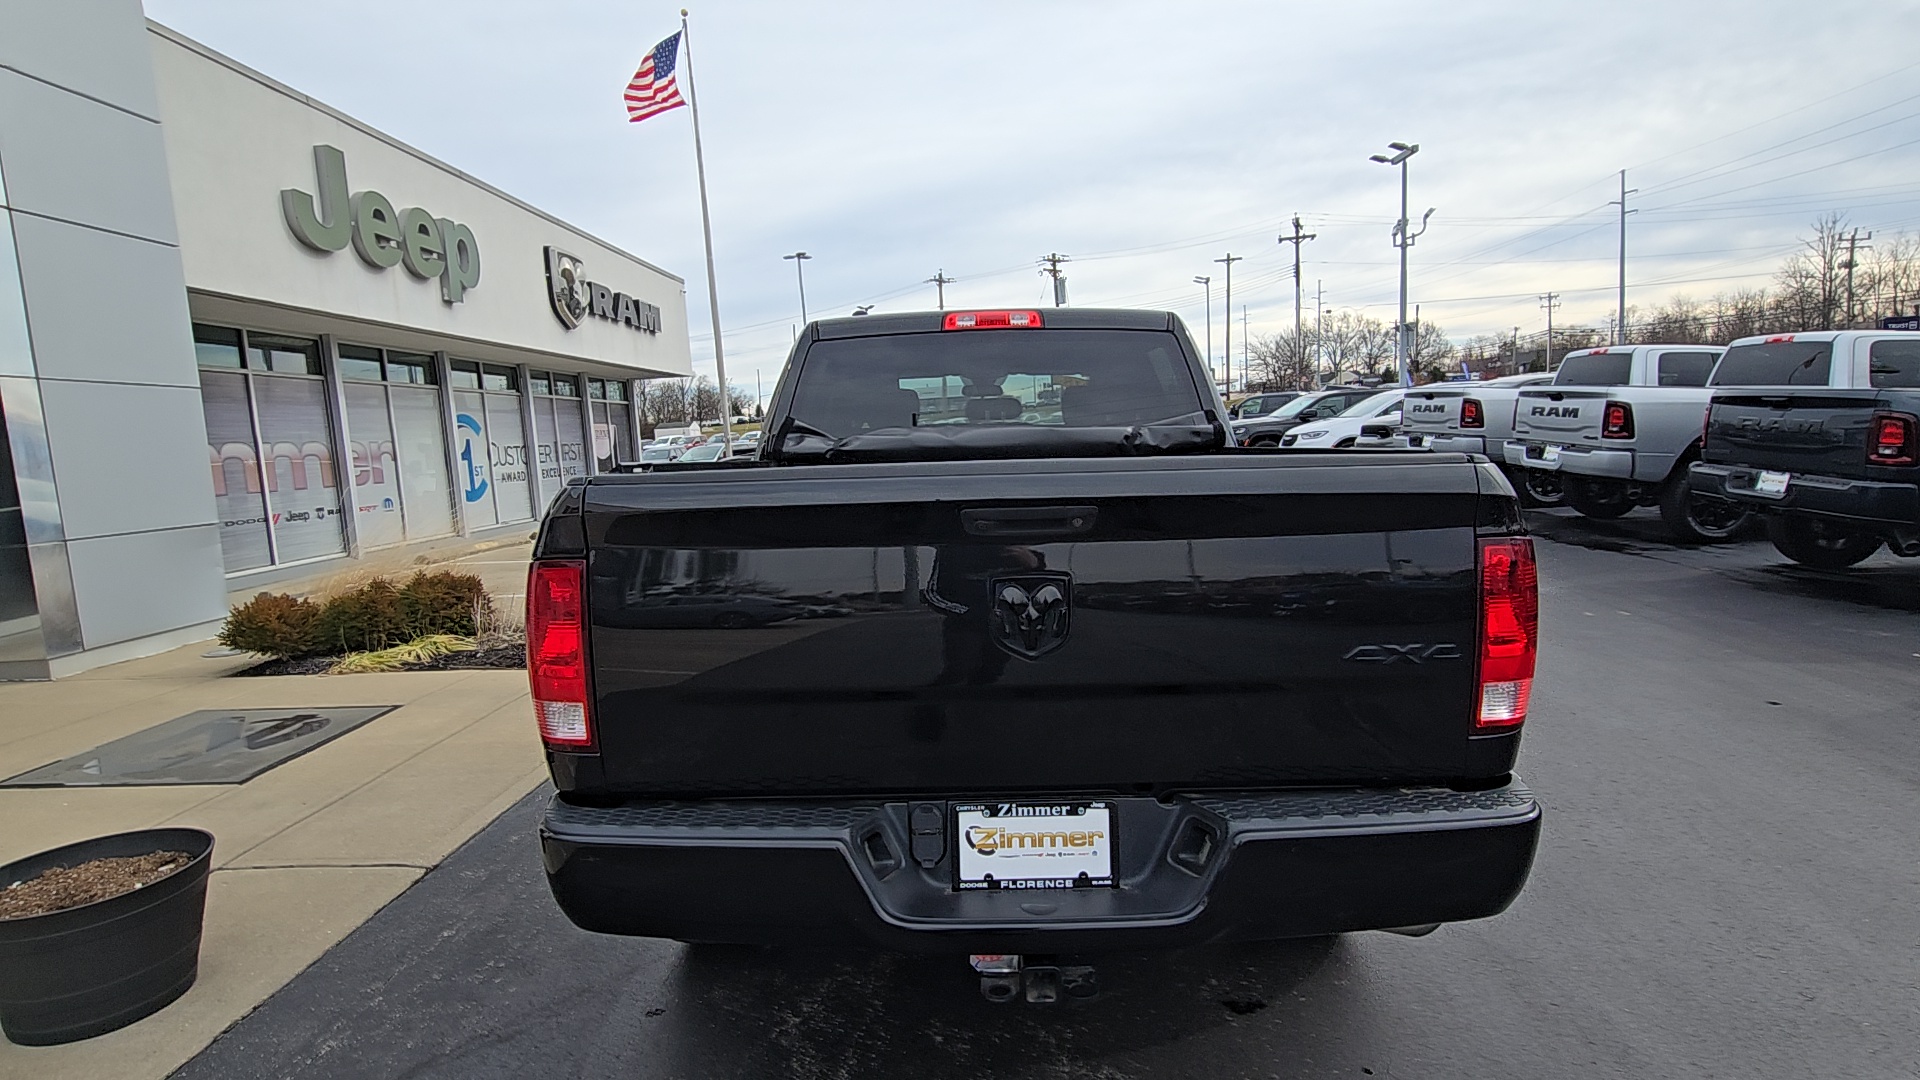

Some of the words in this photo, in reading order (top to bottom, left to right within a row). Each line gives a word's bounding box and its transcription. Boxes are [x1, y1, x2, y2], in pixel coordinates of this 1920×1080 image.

[280, 144, 480, 303] Jeep
[587, 281, 662, 334] RAM
[1412, 404, 1446, 414] RAM
[1530, 406, 1580, 419] RAM
[1737, 415, 1824, 433] RAM
[501, 471, 527, 483] AWARD
[541, 466, 577, 479] EXCELENCE
[285, 510, 310, 523] Jeep
[327, 508, 342, 516] RA
[224, 517, 268, 527] DODG
[997, 803, 1071, 817] Zimmer
[974, 827, 1104, 850] Zimmer
[959, 881, 989, 889] DODGE
[1000, 879, 1074, 889] FLORENCE
